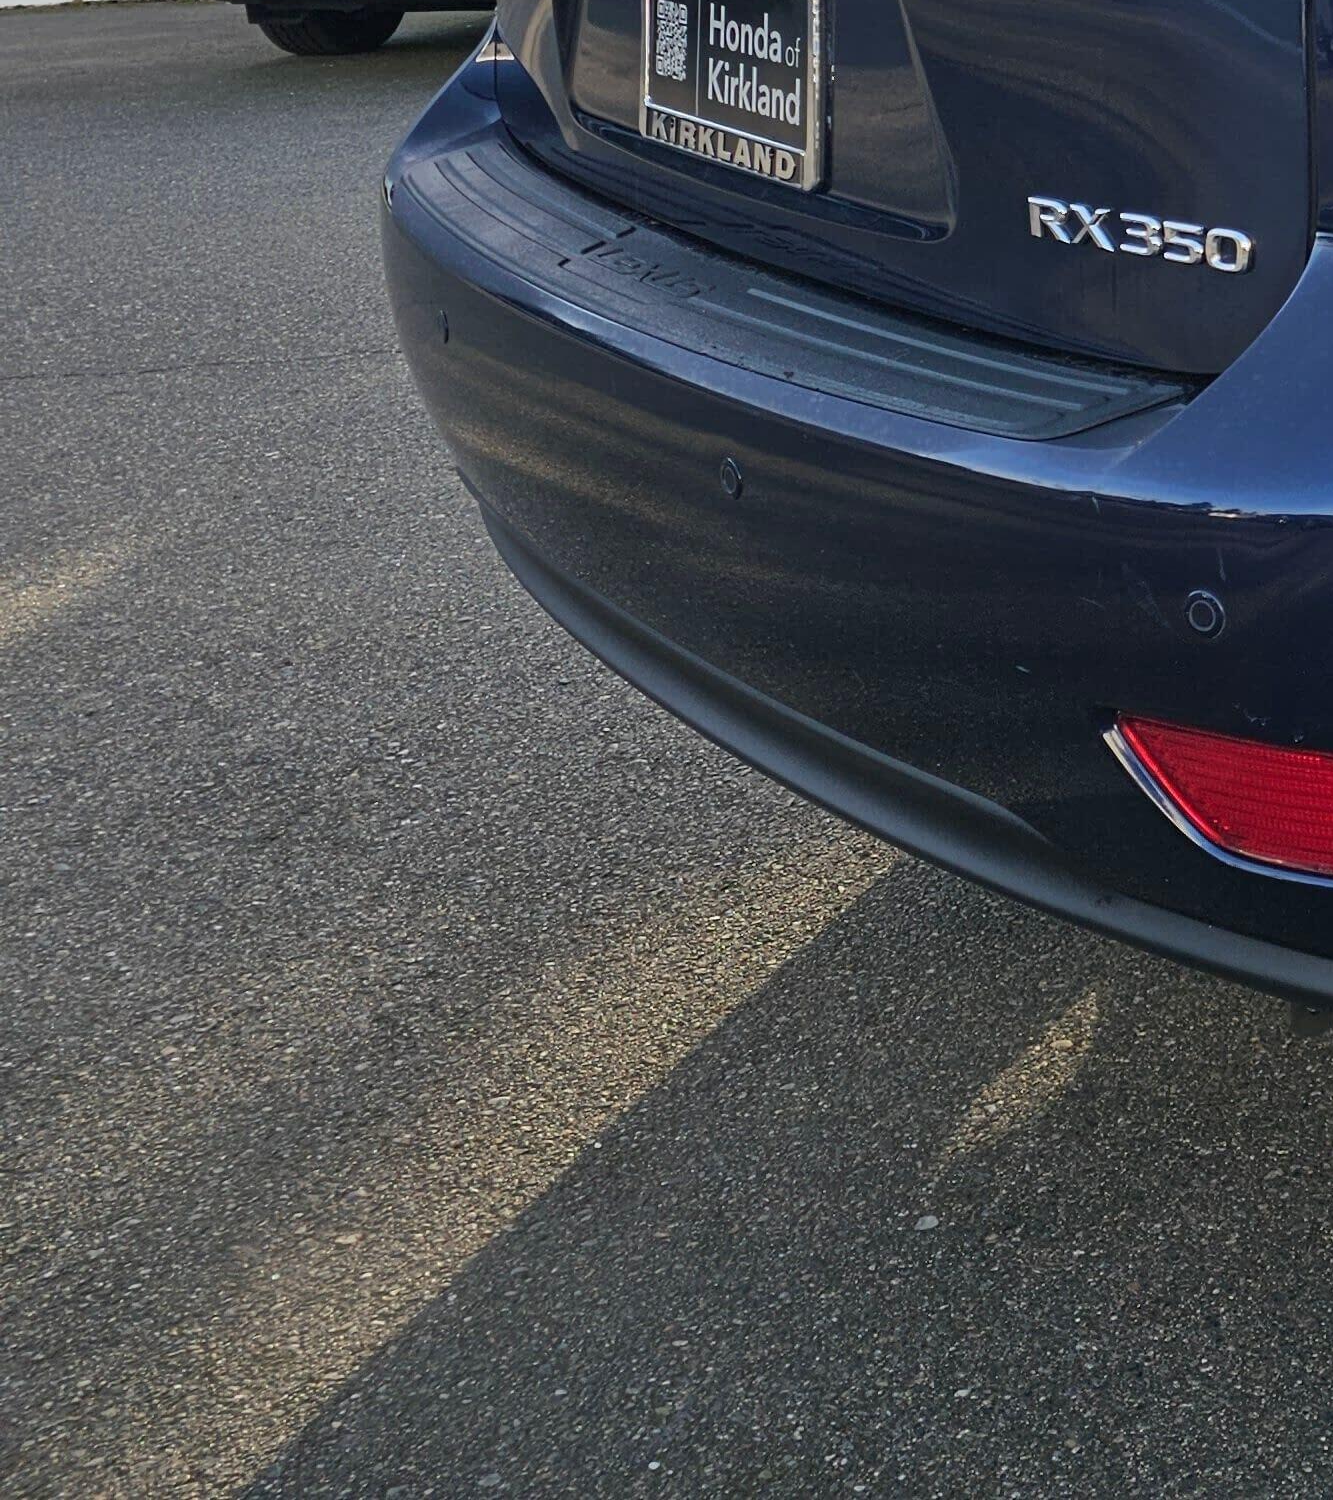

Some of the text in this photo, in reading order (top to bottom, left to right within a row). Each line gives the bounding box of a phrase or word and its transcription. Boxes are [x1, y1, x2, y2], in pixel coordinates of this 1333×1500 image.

[709, 2, 800, 69] Honda of
[707, 58, 800, 126] Kirkland
[652, 110, 796, 181] KIRKLAND
